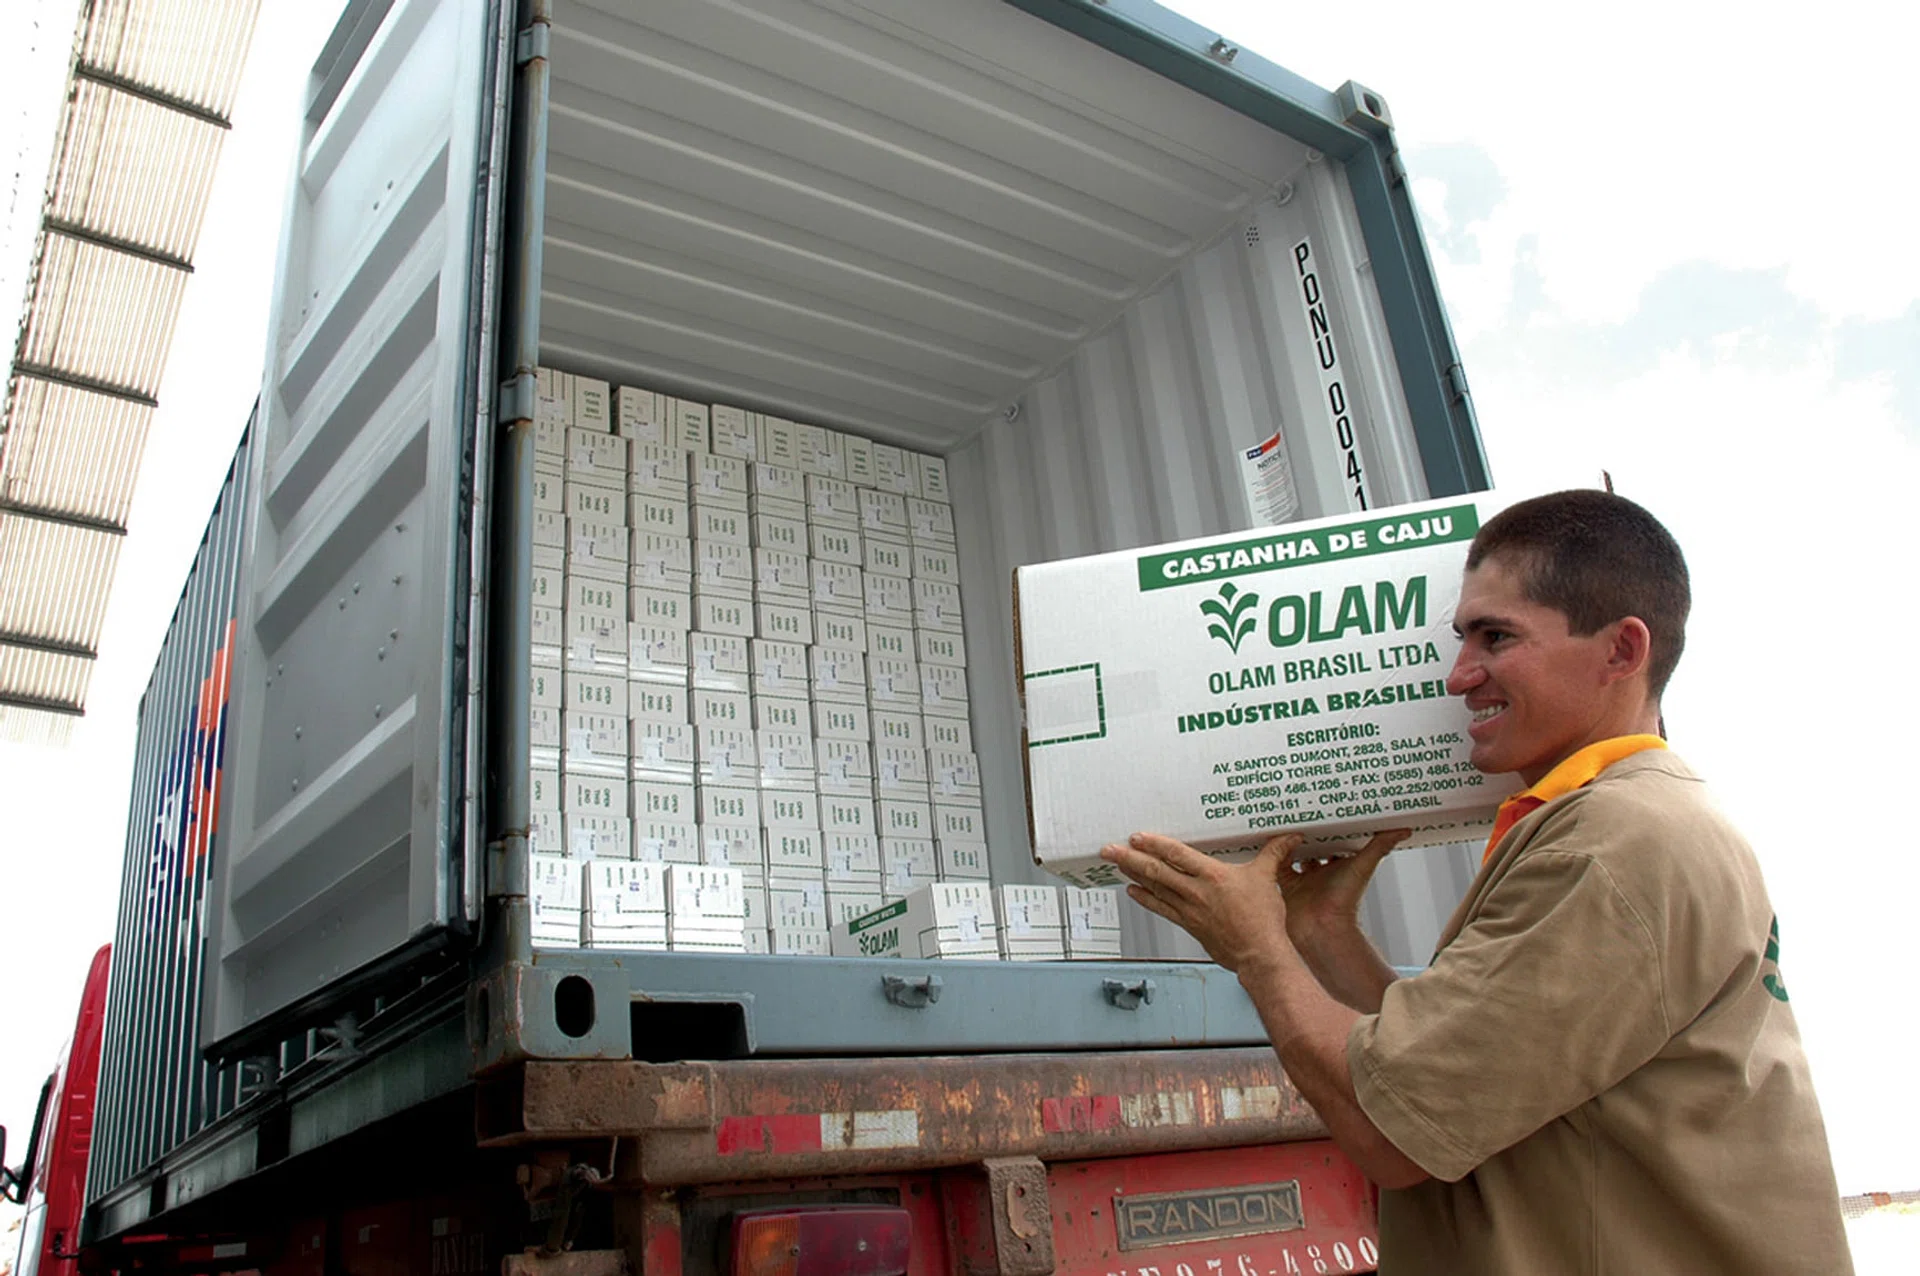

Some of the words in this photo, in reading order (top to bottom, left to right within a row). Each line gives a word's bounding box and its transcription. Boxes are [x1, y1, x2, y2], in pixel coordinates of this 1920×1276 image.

[1294, 241, 1335, 370] PONU
[1162, 538, 1320, 579] CASTANHA
[1328, 530, 1368, 552] DE
[1378, 515, 1454, 545] CAJU
[1268, 575, 1427, 648] OLAM
[1208, 664, 1276, 694] OLAM
[1283, 651, 1371, 684] BRASIL
[1378, 641, 1440, 670] LTDA
[1177, 697, 1320, 734] INDÚSTRIA
[1327, 679, 1446, 712] BRASILEI
[1212, 762, 1232, 775] AV.
[1234, 754, 1288, 772] SANTOS
[1290, 746, 1350, 764] DUMONT,
[1352, 742, 1388, 757] 2828,
[1390, 736, 1426, 751] SALA
[1287, 722, 1381, 747] ESCRITÓRIO:
[1200, 790, 1241, 805] FONE:
[1243, 785, 1282, 802] (5585)
[1351, 772, 1381, 786] FAX:
[1383, 767, 1424, 784] (5585)
[1426, 760, 1477, 777] 486.120
[1226, 770, 1284, 788] EDIFÍCIO
[1286, 763, 1333, 780] TORRE
[1335, 756, 1390, 774] SANTOS
[1393, 748, 1453, 766] DUMONT
[1204, 805, 1236, 820] CEP:
[1318, 791, 1360, 806] CNPJ:
[1248, 810, 1325, 829] FORTALEZA
[1335, 800, 1382, 818] CEARÁ
[1393, 795, 1443, 812] BRASIL
[869, 926, 899, 956] OLAM
[1129, 1192, 1295, 1237] RANDON
